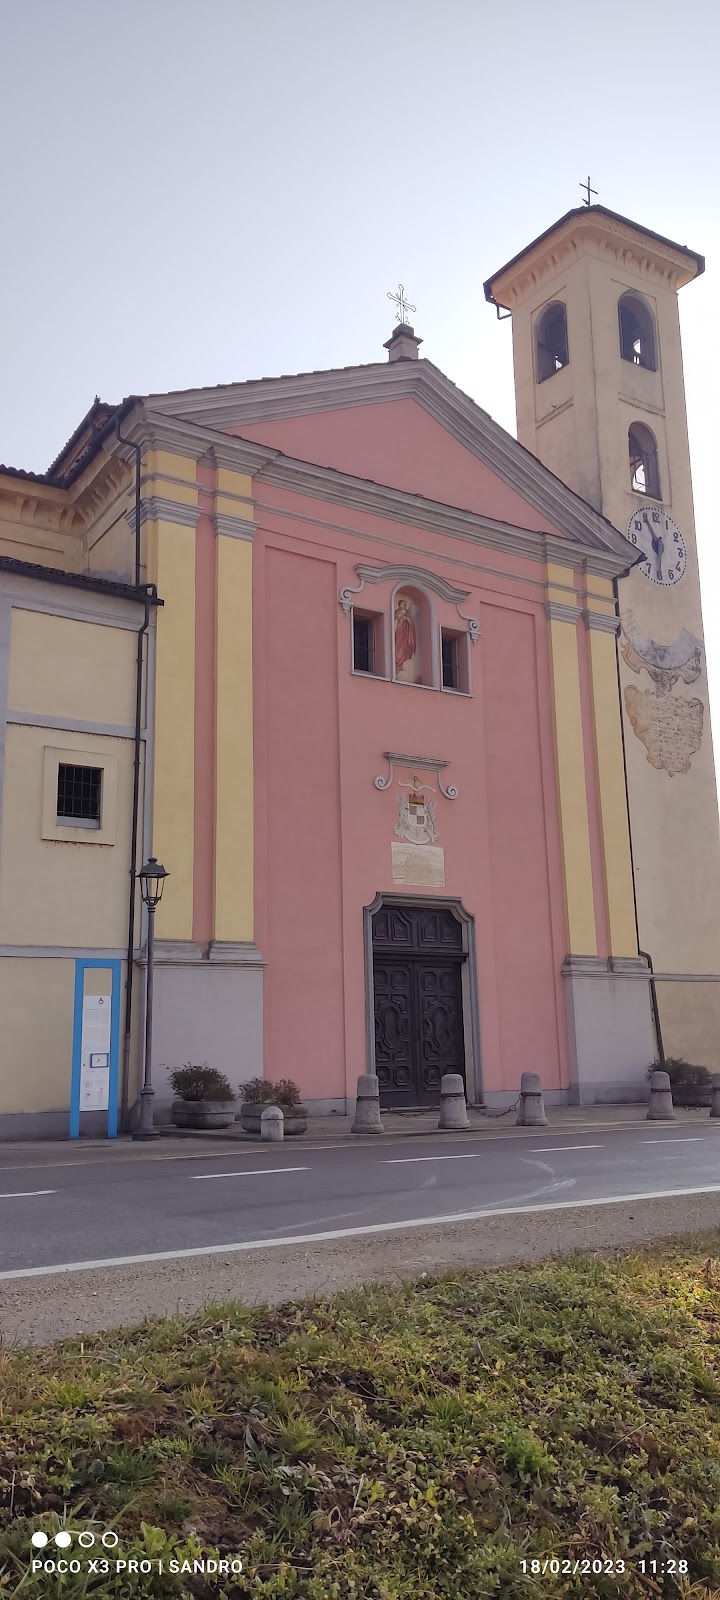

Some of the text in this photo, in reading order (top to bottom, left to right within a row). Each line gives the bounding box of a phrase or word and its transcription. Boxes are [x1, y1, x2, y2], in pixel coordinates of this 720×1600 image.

[652, 512, 660, 524] 12
[634, 520, 642, 531] 10
[665, 520, 669, 530] 1
[631, 533, 637, 544] 9
[673, 532, 679, 543] 2
[677, 548, 684, 558] 3
[646, 563, 652, 574] 7
[675, 561, 681, 572] 4
[657, 570, 663, 580] 6
[668, 569, 674, 580] 5
